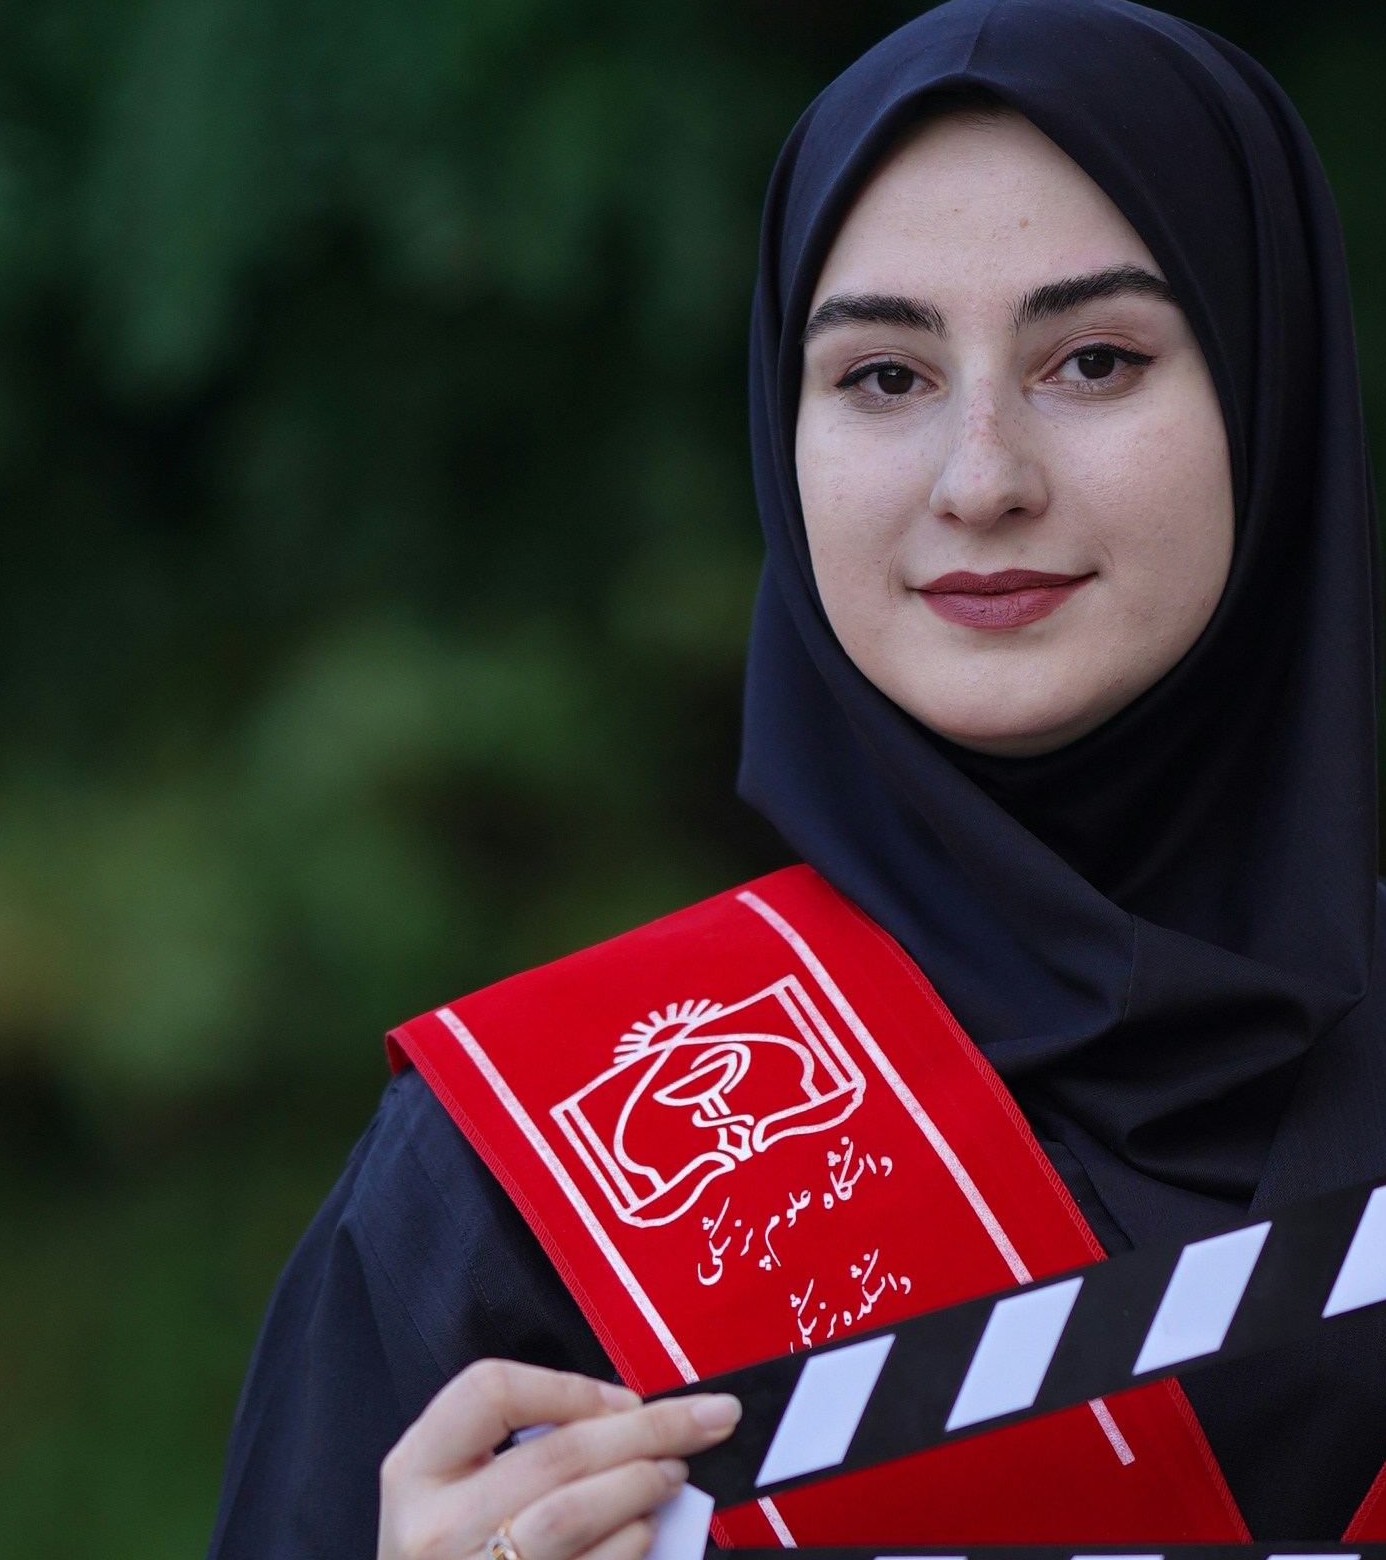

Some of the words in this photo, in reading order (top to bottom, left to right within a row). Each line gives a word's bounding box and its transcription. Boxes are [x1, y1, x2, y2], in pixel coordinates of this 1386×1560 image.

[822, 1136, 894, 1210] دانشگاه
[696, 1196, 774, 1286] پزشکی
[764, 1189, 812, 1268] علوم
[842, 1248, 912, 1327] دانشکده
